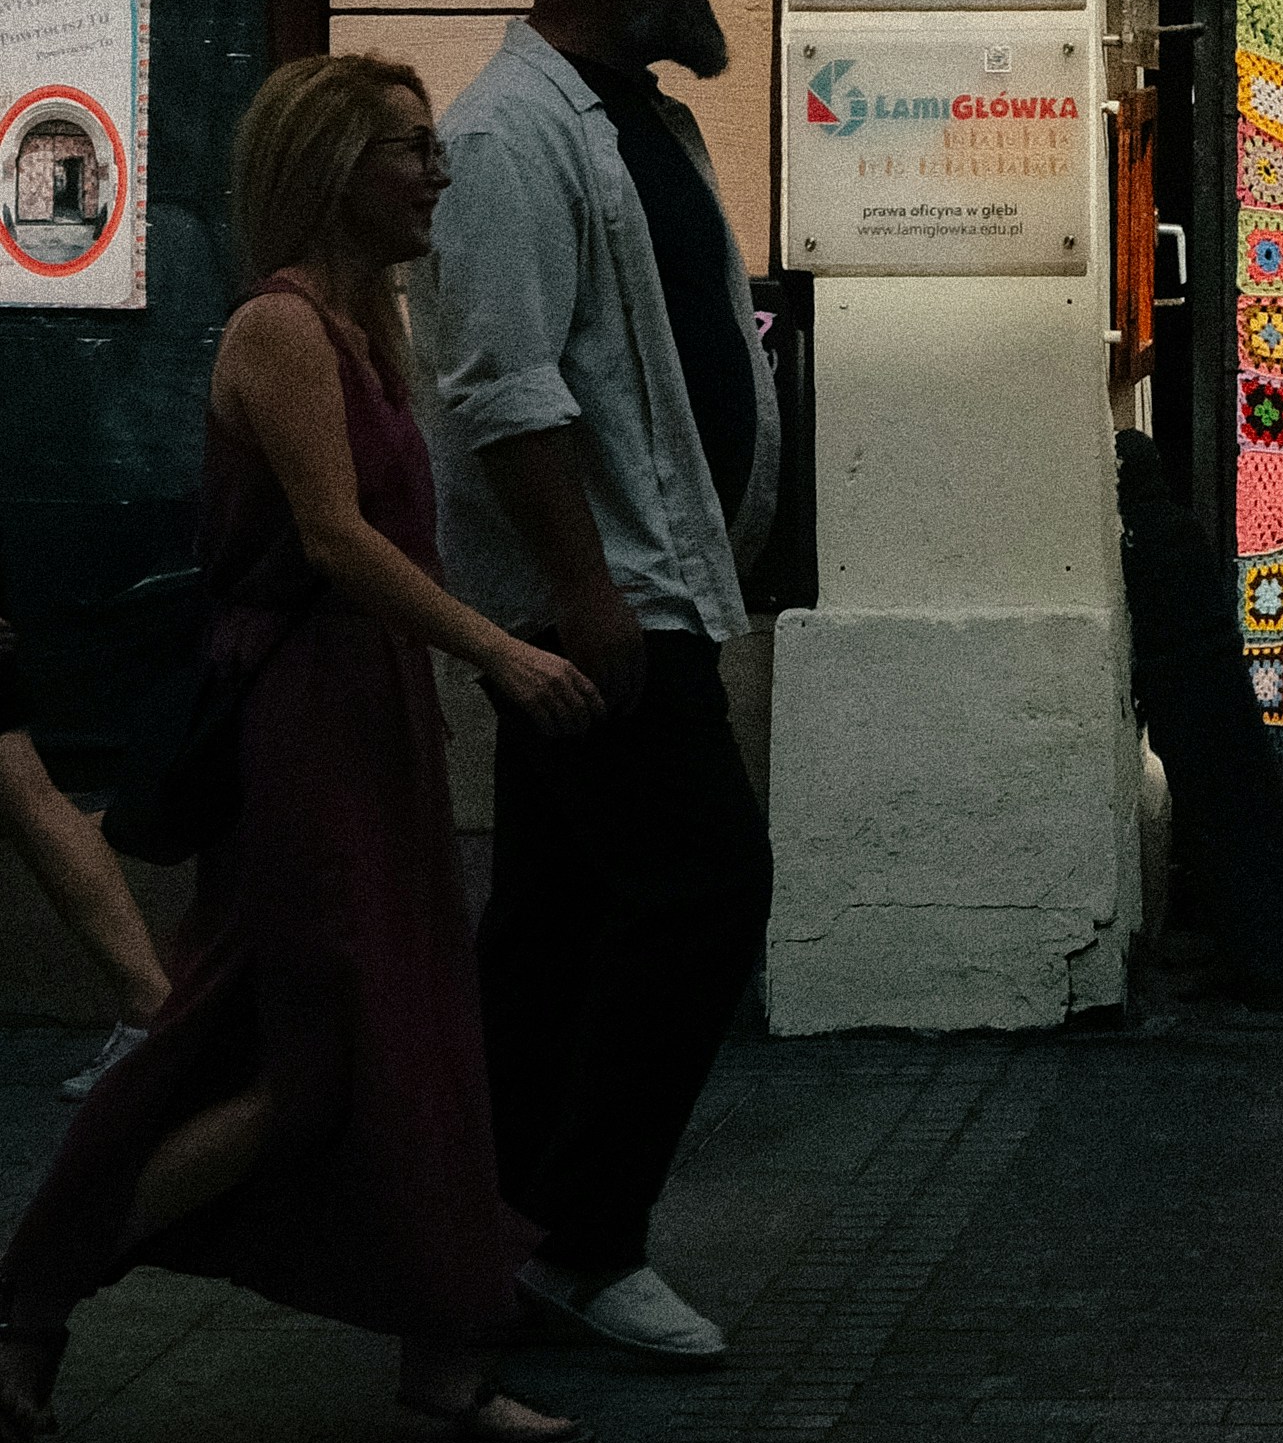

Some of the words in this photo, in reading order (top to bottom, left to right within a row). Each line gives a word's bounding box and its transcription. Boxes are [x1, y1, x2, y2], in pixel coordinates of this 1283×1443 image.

[874, 91, 1080, 121] ŁAMIGŁÓWKA
[862, 206, 907, 220] prawa
[910, 203, 962, 220] oficyna
[966, 206, 979, 217] w
[981, 203, 1019, 220] głębi
